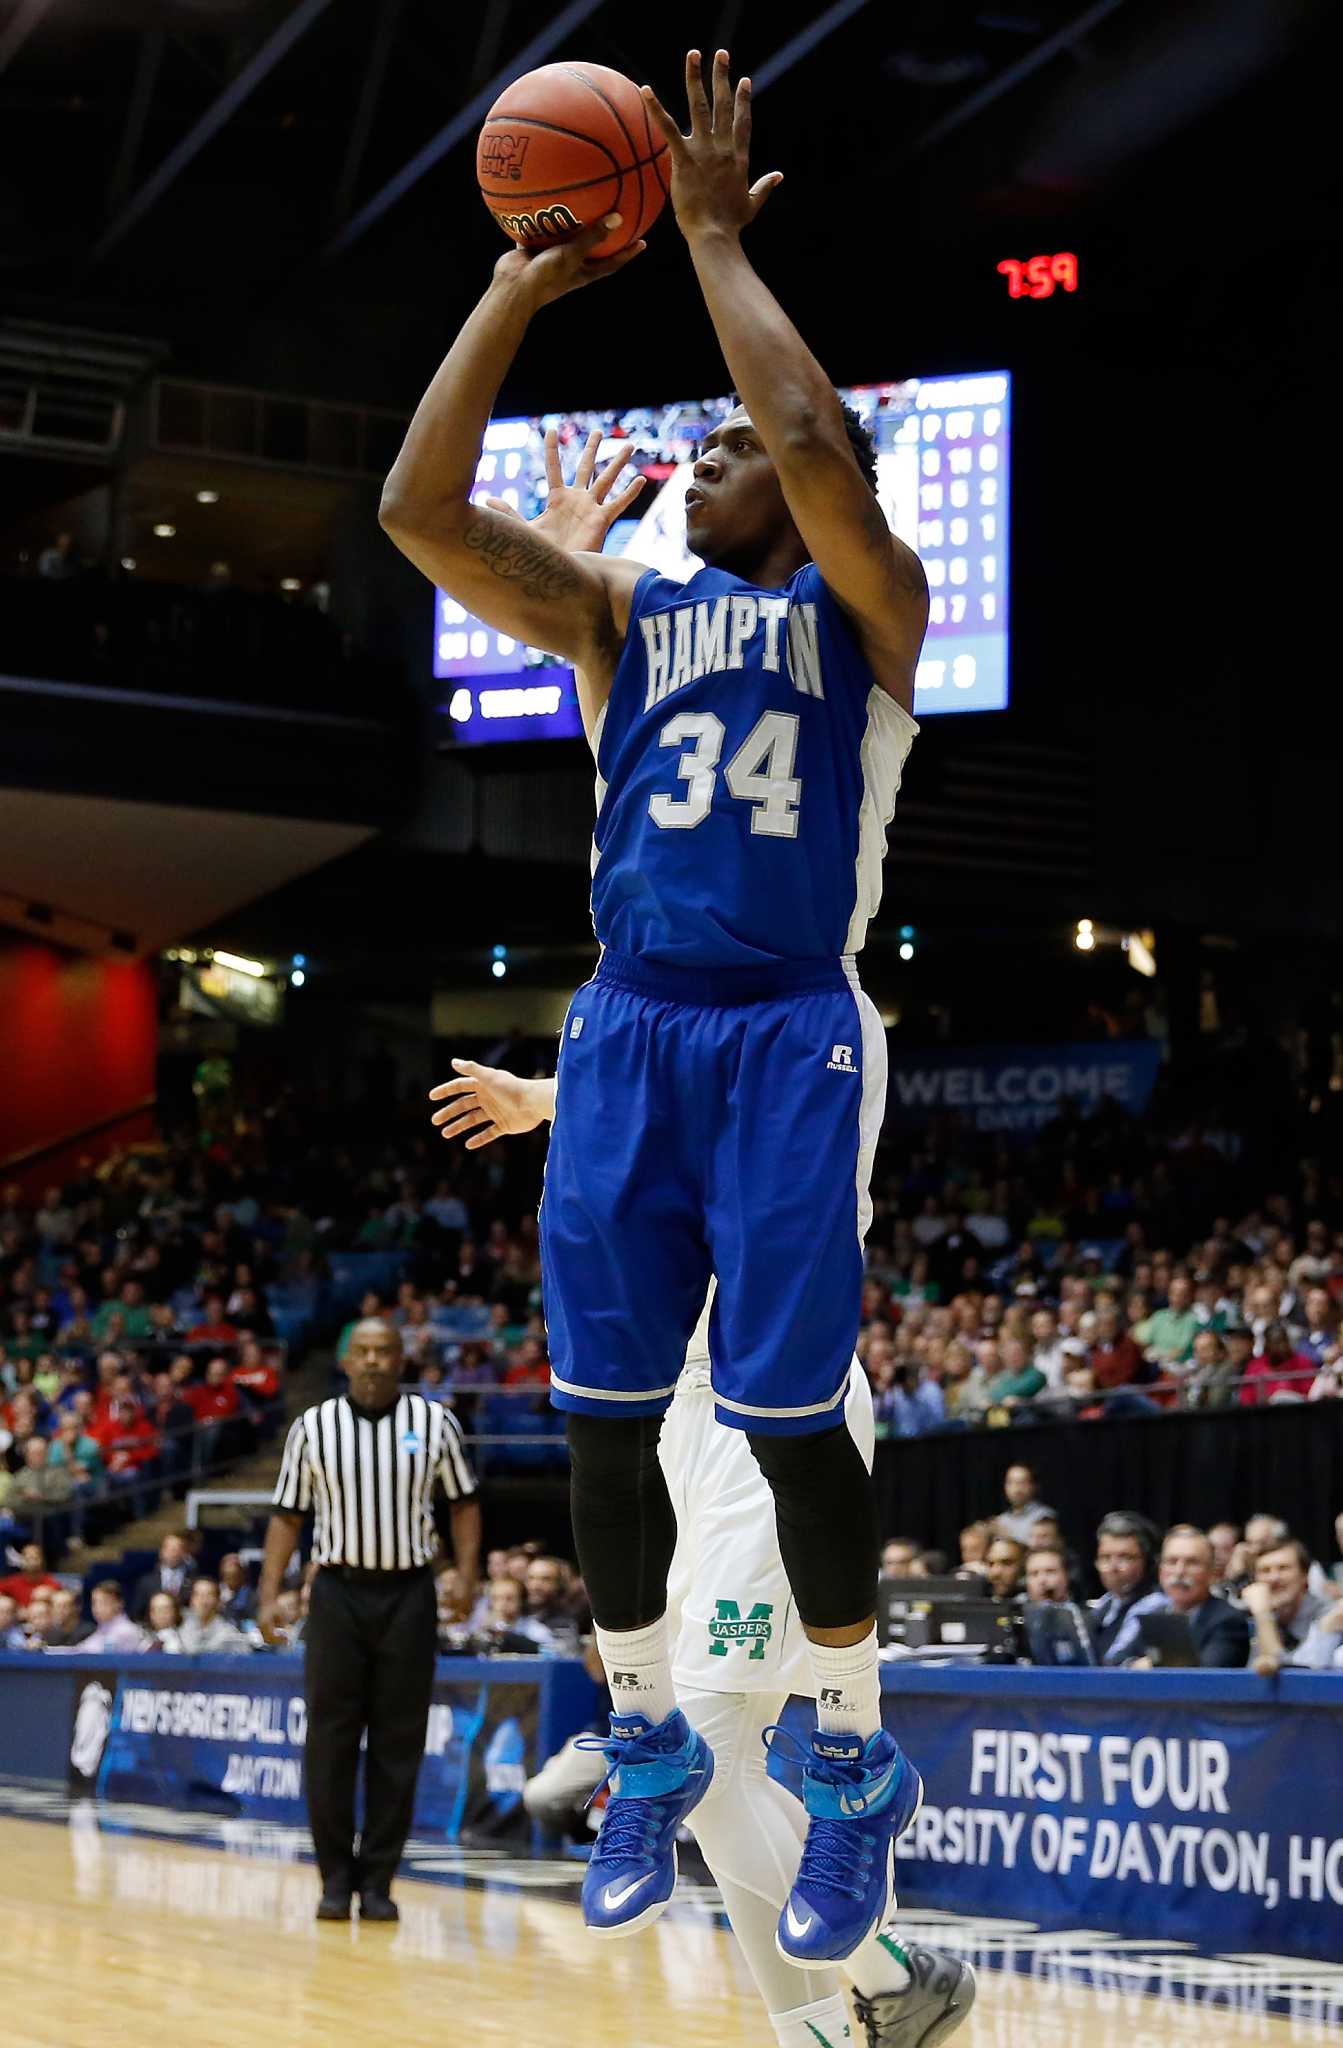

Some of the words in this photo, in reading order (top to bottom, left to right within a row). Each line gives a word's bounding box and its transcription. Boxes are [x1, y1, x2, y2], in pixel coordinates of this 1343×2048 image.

[997, 252, 1078, 299] 7:59
[639, 595, 825, 714] HAMPTN
[648, 710, 802, 838] 34
[895, 1065, 1133, 1105] WELCOME
[712, 1623, 770, 1636] JASPERS
[969, 1728, 1092, 1803] FIRST
[1099, 1735, 1231, 1814] FOUR
[1030, 1812, 1090, 1876] OF
[1089, 1818, 1281, 1910] DAYTON,
